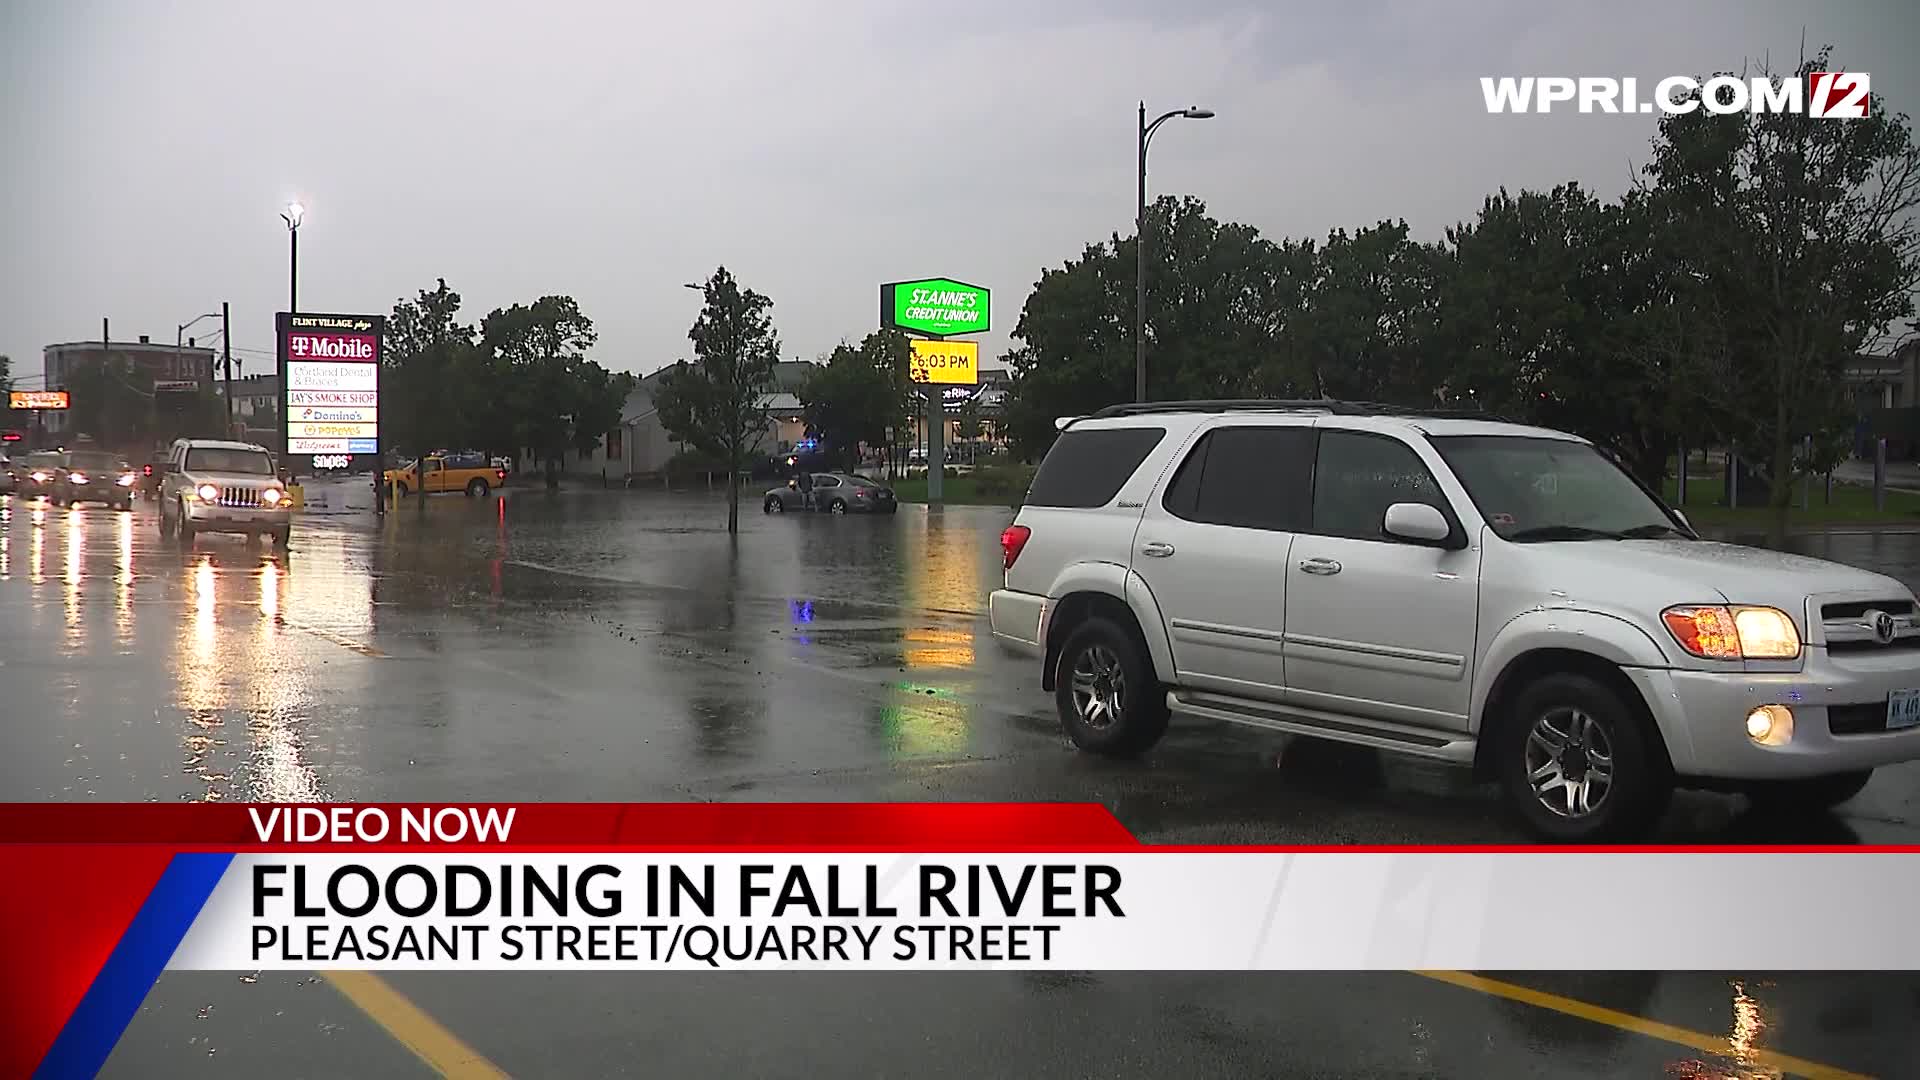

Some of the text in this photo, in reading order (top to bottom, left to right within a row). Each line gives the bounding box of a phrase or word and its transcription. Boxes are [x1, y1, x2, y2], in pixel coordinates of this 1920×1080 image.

[905, 307, 979, 323] CREDIT UNION
[292, 317, 317, 327] FLINT
[318, 318, 353, 328] VILLAGE
[311, 336, 373, 358] Mobile
[917, 354, 969, 368] 6:03 PM
[340, 367, 372, 377] Dental
[294, 376, 339, 386] & Braces
[291, 393, 375, 404] JAY'S SMOKE SHOP
[314, 411, 362, 420] Domino's
